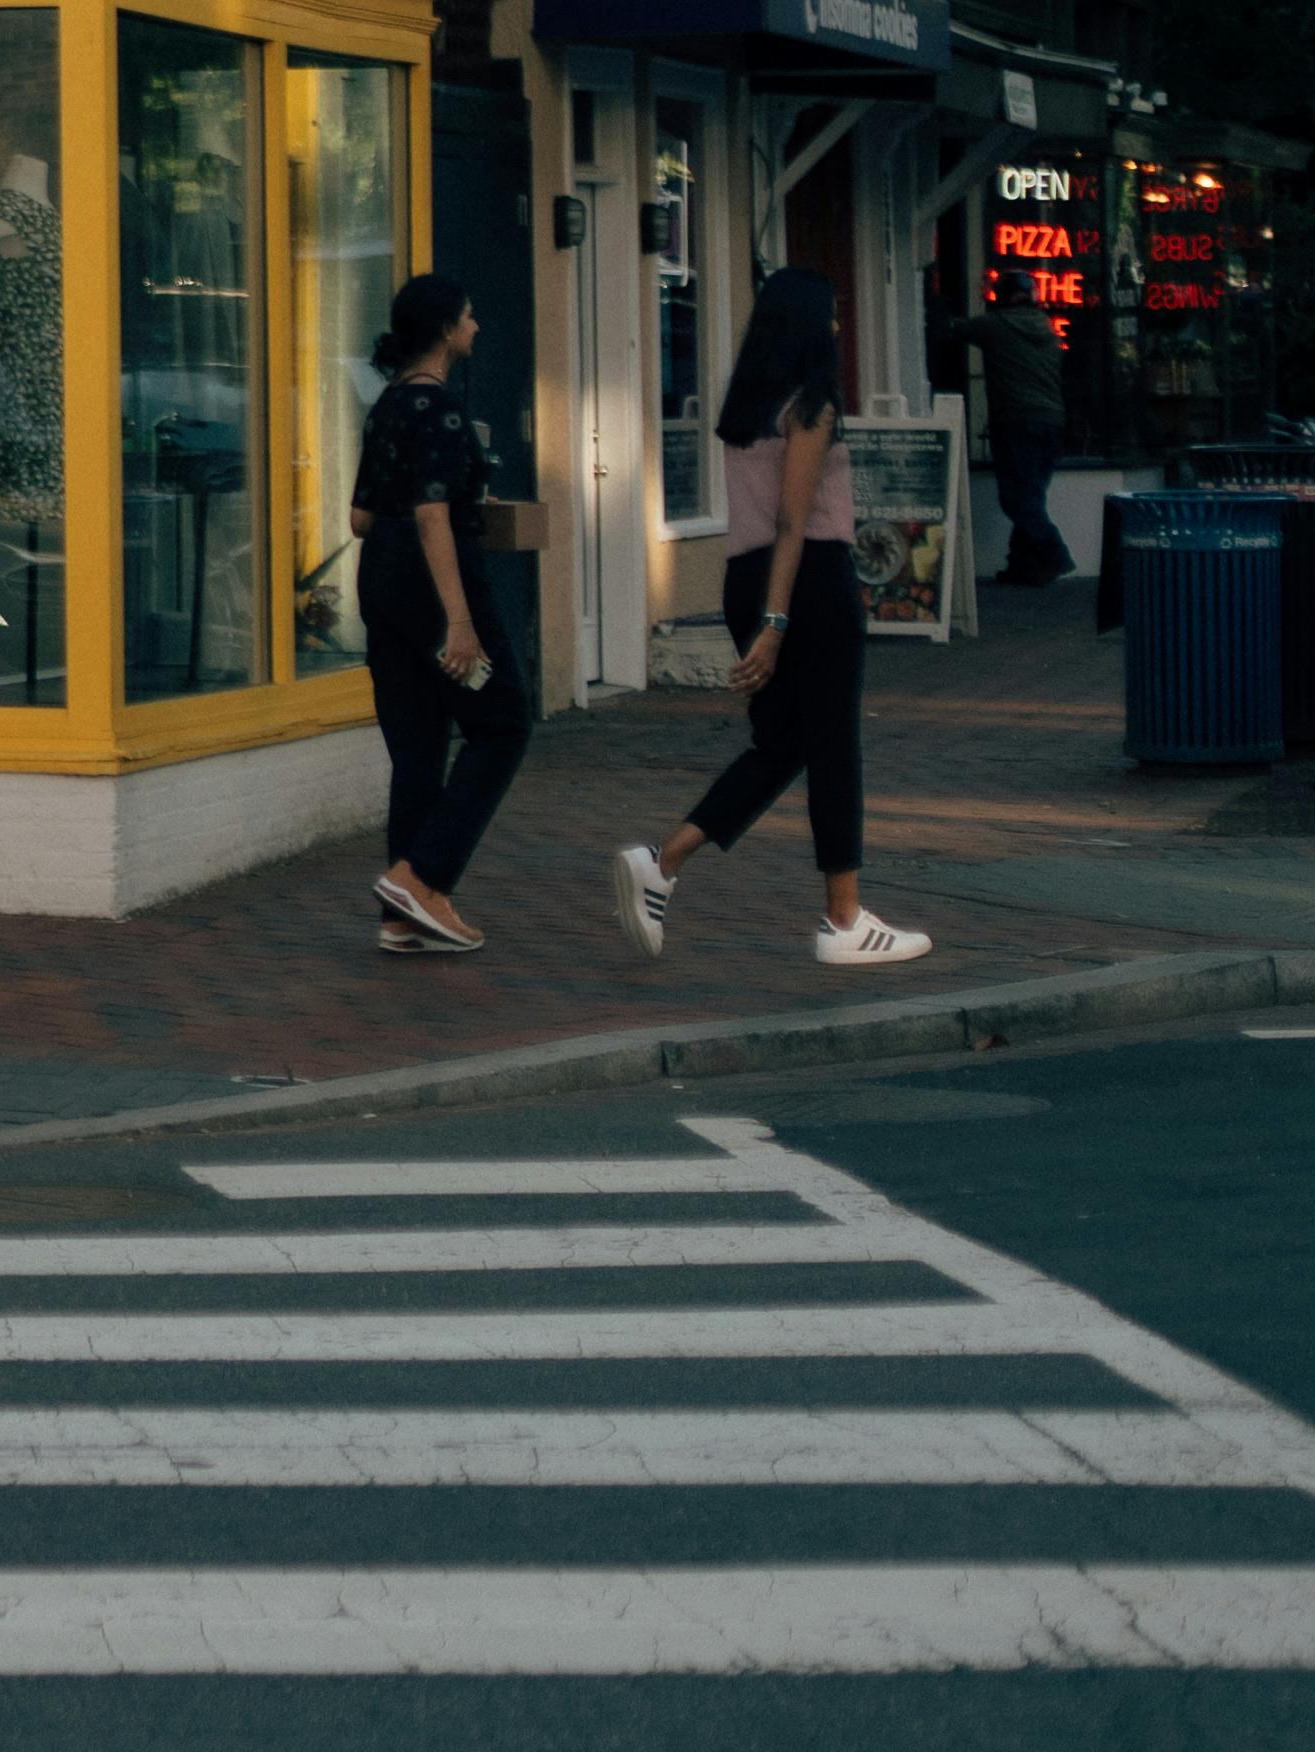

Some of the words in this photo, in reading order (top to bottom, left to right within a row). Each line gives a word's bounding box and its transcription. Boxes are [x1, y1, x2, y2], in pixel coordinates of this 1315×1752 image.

[1000, 166, 1070, 201] OPEN
[996, 223, 1072, 258] PIZZA
[1034, 271, 1083, 305] THE
